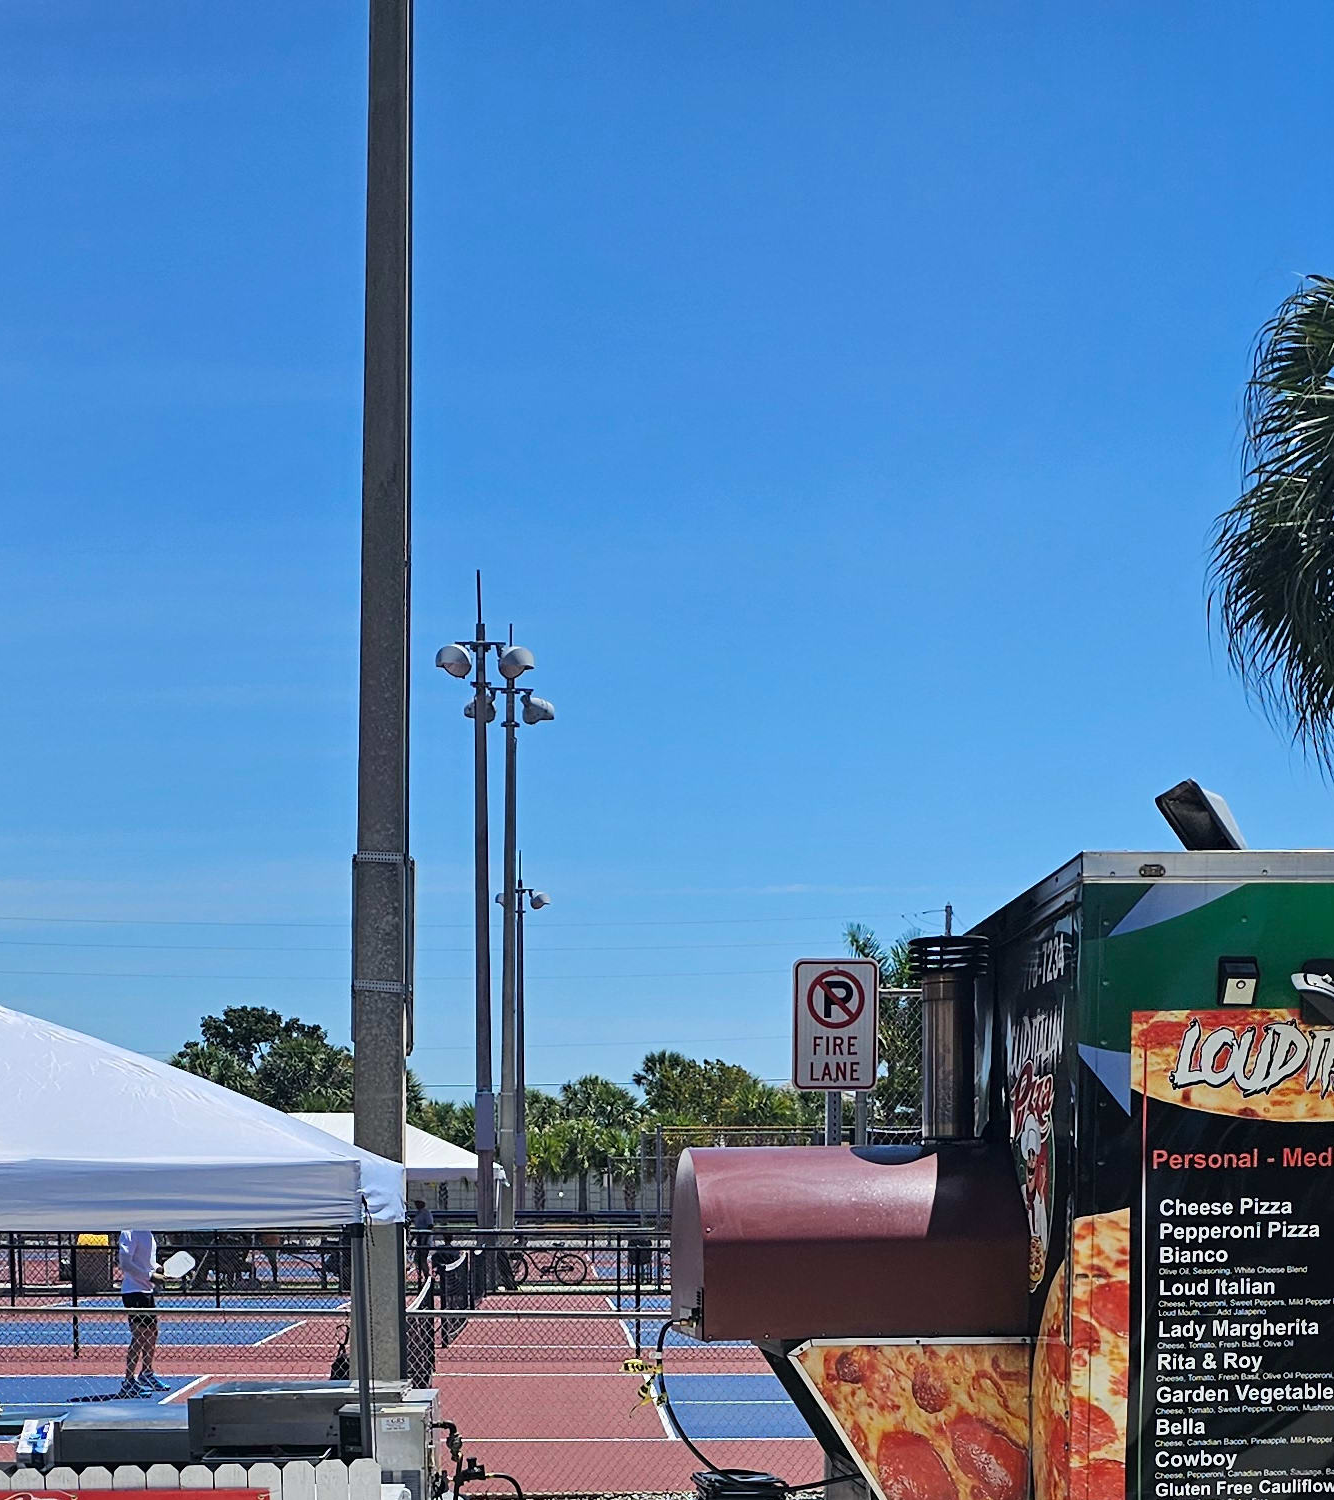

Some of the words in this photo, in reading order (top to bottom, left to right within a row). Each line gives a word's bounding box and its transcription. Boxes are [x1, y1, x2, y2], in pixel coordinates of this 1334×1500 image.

[813, 1036, 858, 1056] FIRE
[1169, 1018, 1310, 1097] LOUD
[810, 1061, 860, 1082] LANE
[1153, 1148, 1258, 1170] Personal
[1160, 1199, 1233, 1216] Cheese
[1240, 1198, 1292, 1215] Pizza
[1159, 1222, 1261, 1243] Pepperoni
[1268, 1222, 1320, 1238] Pizza
[1160, 1247, 1228, 1263] Bianco
[1160, 1279, 1208, 1295] Loud
[1216, 1278, 1275, 1295] Italian
[1159, 1321, 1206, 1340] Lady
[1213, 1319, 1318, 1340] Margherita
[1158, 1353, 1196, 1370] Rita
[1202, 1353, 1217, 1369] &
[1224, 1352, 1262, 1372] Roy
[1156, 1386, 1229, 1403] Garden
[1235, 1383, 1334, 1404] Vegetable
[1156, 1418, 1205, 1436] Bella
[1155, 1450, 1237, 1470] Cowboy
[1155, 1482, 1210, 1497] Gluten
[1217, 1481, 1252, 1496] Free
